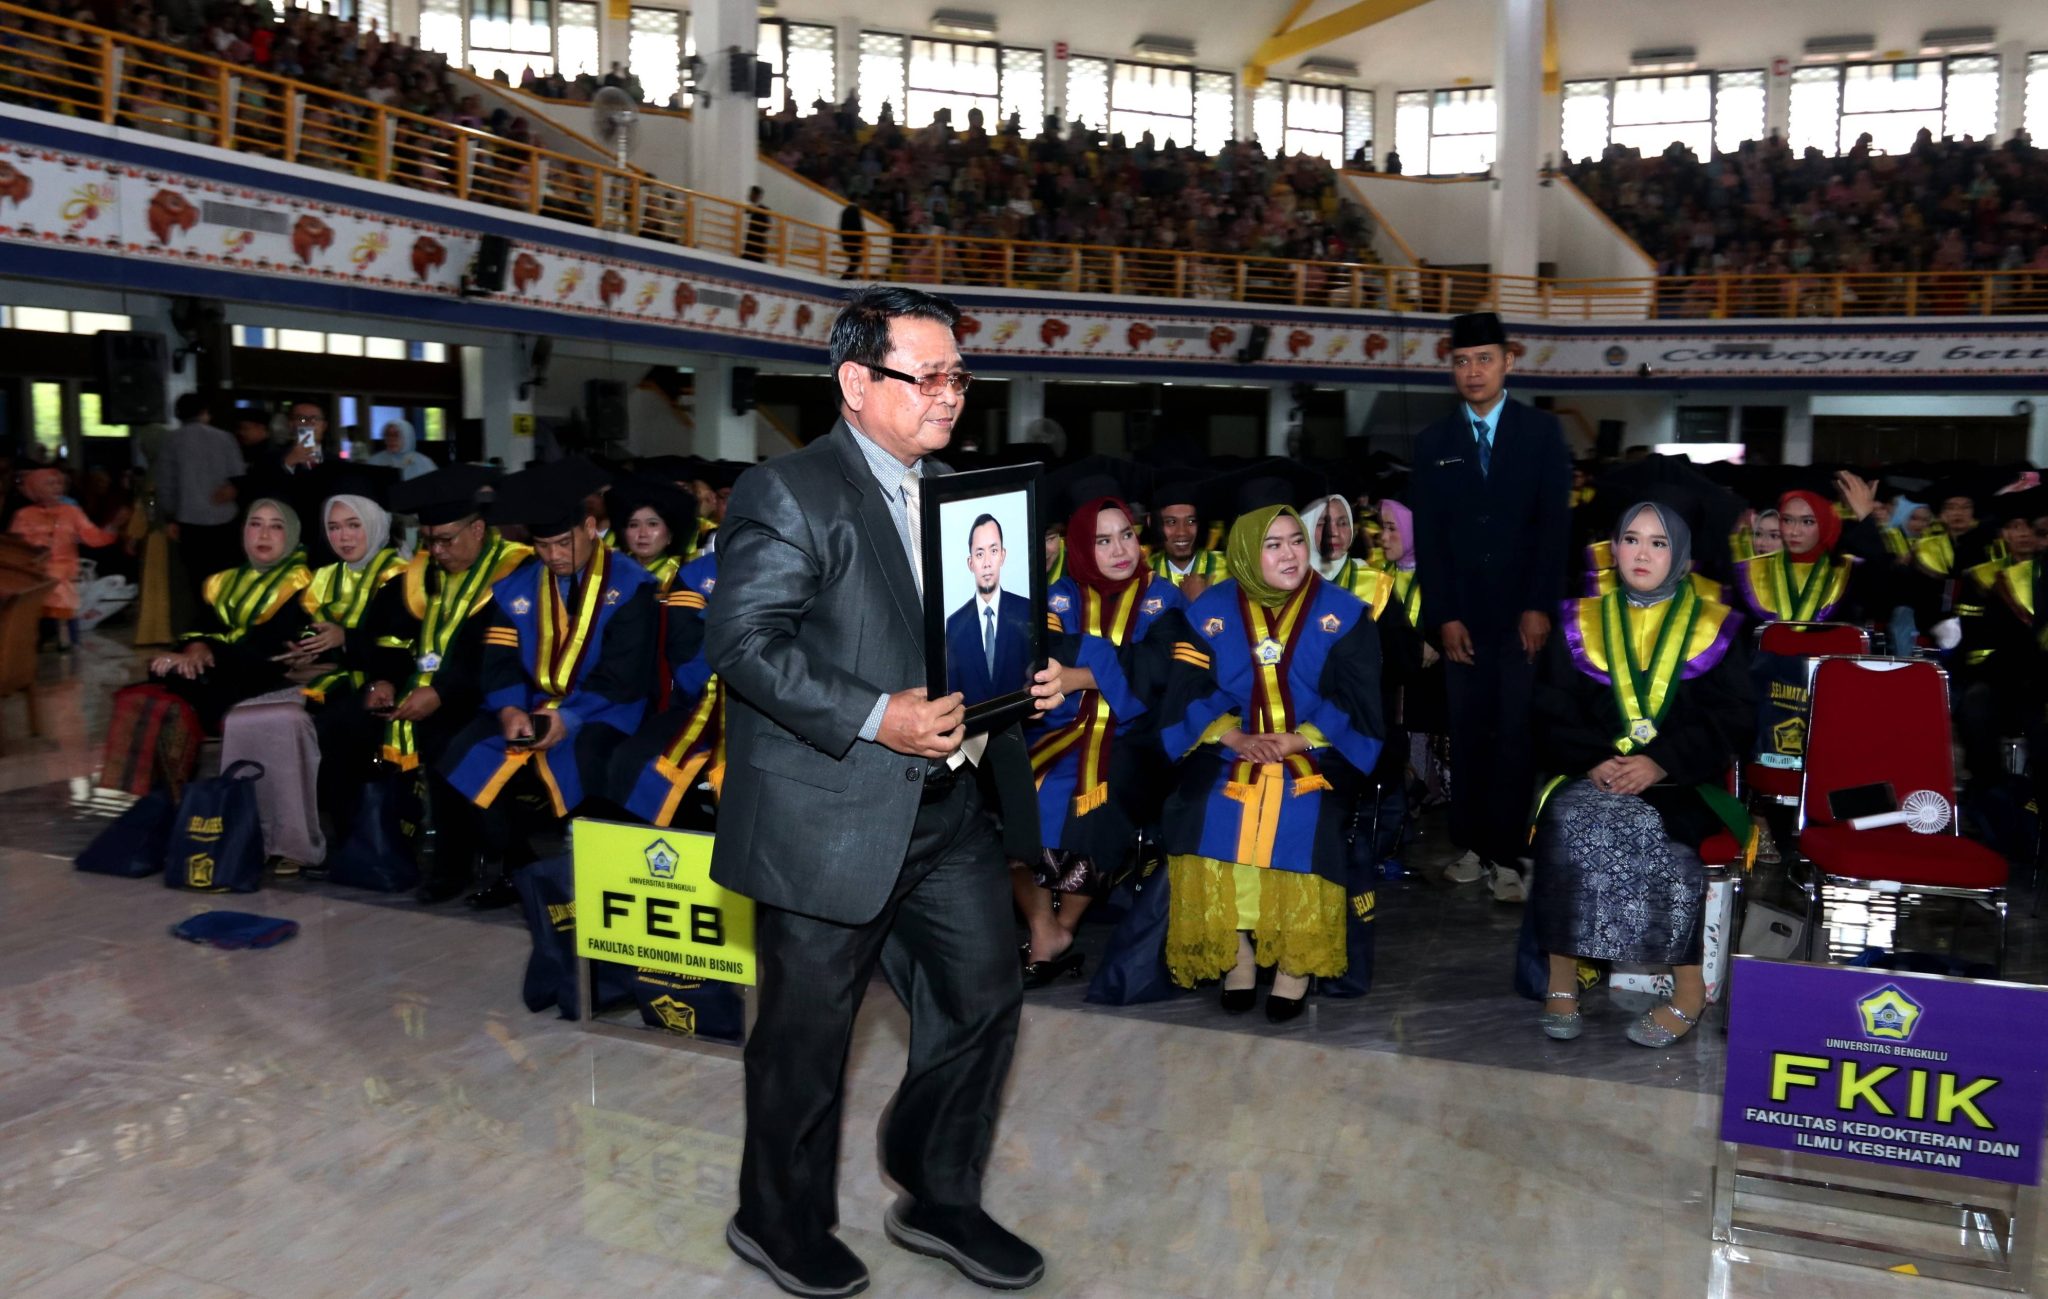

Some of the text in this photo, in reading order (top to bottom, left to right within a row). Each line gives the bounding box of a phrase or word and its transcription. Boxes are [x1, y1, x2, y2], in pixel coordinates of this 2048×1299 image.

[1660, 346, 1921, 364] Conveying
[629, 876, 697, 893] UNIVERSITAS BENGKULU
[602, 890, 725, 947] FEB
[588, 937, 635, 957] FAKULTAS
[637, 945, 683, 965] EKONOMI
[685, 954, 707, 969] DAN
[709, 957, 744, 975] BISNIS
[1826, 1038, 1948, 1062] UNIVERSITAS BENGKULU
[1768, 1051, 2001, 1130] FKIK
[1746, 1107, 2020, 1158] FAKULTAS KEDOKTERAN DAN
[1796, 1132, 1961, 1169] ILMU KESEHATAN
